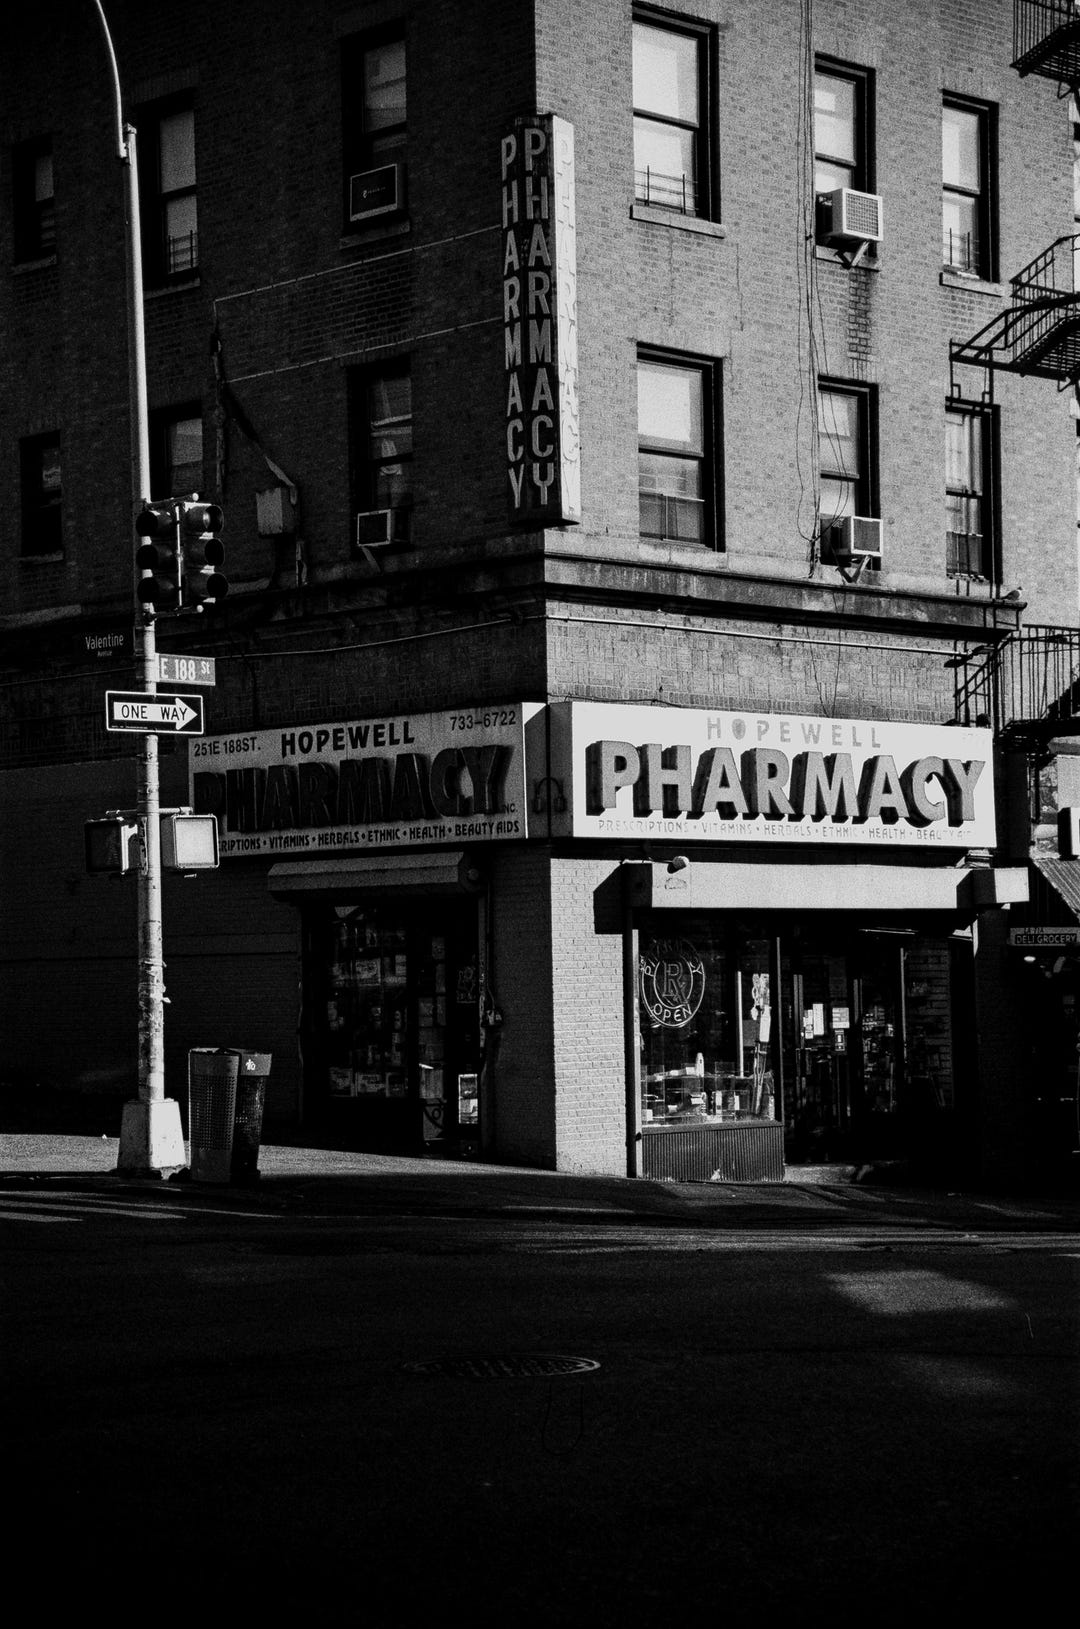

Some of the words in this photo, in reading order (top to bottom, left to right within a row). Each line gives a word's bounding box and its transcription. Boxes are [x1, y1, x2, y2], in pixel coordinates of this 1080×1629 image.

[501, 133, 525, 509] PHARMACY
[524, 127, 555, 505] PHARMACY
[85, 633, 124, 650] Valentine
[160, 658, 168, 678] E
[174, 659, 195, 680] 188
[200, 661, 210, 674] St
[121, 705, 148, 719] ONE
[160, 706, 187, 720] WAY
[450, 710, 516, 731] 733-6722
[281, 721, 415, 758] HOPEWELL
[707, 716, 881, 748] HOPEWELL
[194, 741, 220, 757] 251E
[223, 737, 261, 754] 188ST.
[193, 745, 515, 834] PHARMACY
[585, 740, 986, 828] PHARMACY
[504, 803, 518, 815] NC.
[219, 838, 261, 852] RIPTIONS
[269, 835, 310, 849] VITAMINS
[318, 831, 360, 846] HERBALS
[368, 829, 400, 842] ETHNIC
[409, 825, 445, 840] HEALTH
[455, 822, 494, 837] BEAUTY
[497, 820, 520, 834] AIDS
[702, 821, 751, 835] VITAMINS
[764, 824, 812, 837] HERBALS
[869, 828, 906, 840] HEALTH
[1037, 934, 1076, 944] GROCERY
[652, 1003, 692, 1022] OPEN
